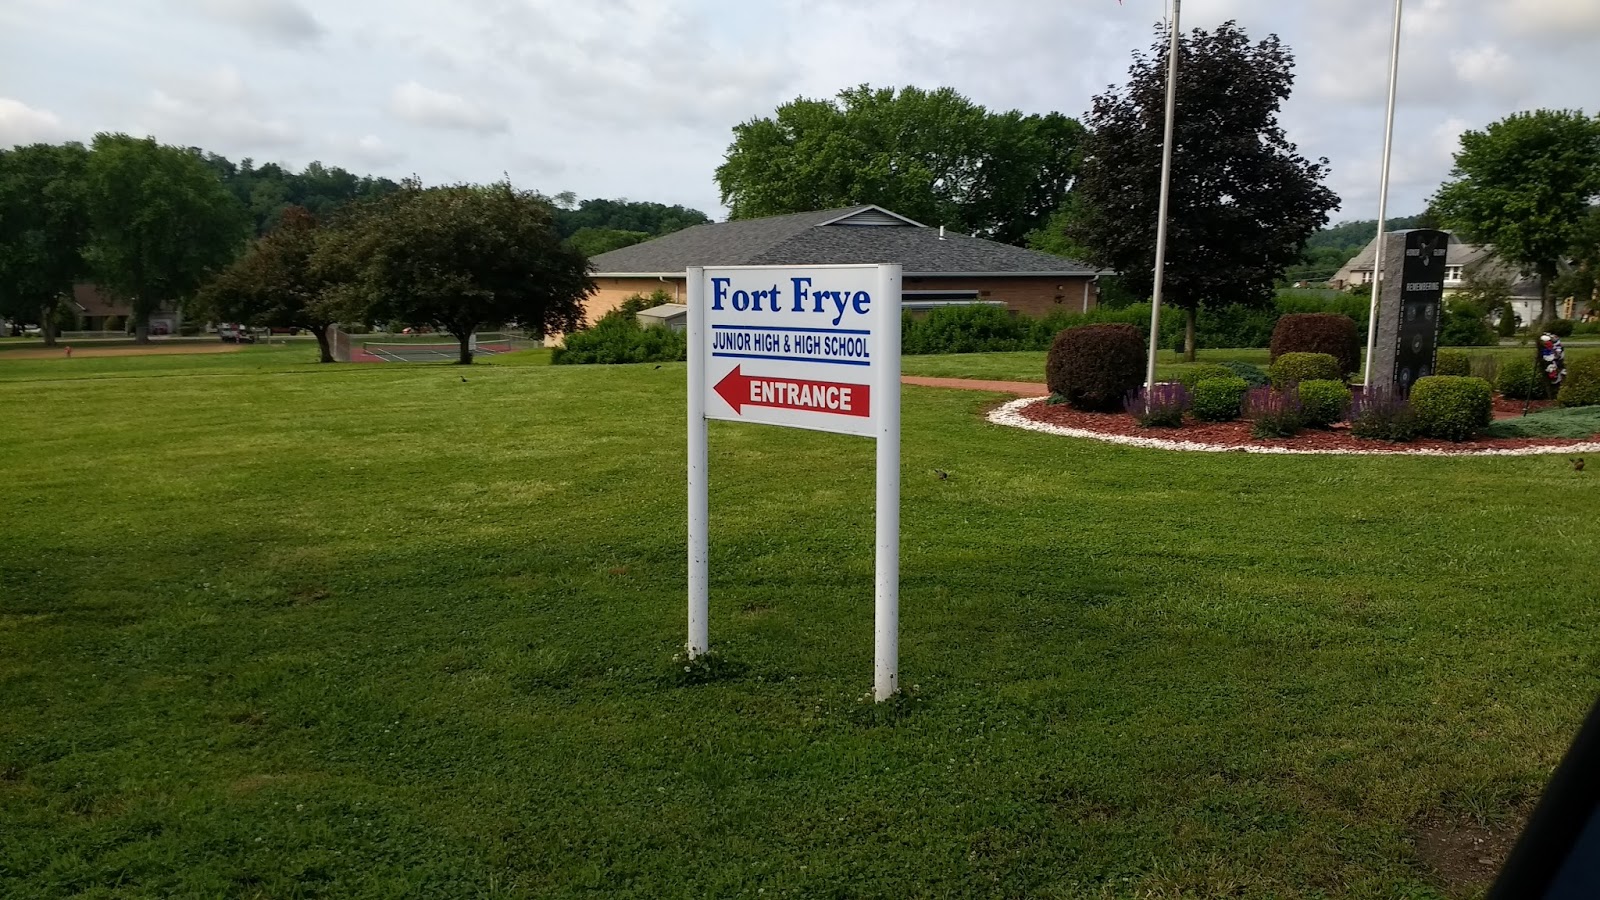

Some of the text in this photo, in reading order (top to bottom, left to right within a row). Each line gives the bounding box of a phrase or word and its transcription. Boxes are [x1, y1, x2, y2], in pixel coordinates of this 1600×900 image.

[1406, 282, 1440, 291] REMEMBERING
[711, 277, 871, 326] Fort Frye
[713, 332, 870, 358] JUNIOR HIGH & HIGH SCHOOL
[749, 380, 852, 411] ENTRANCE
